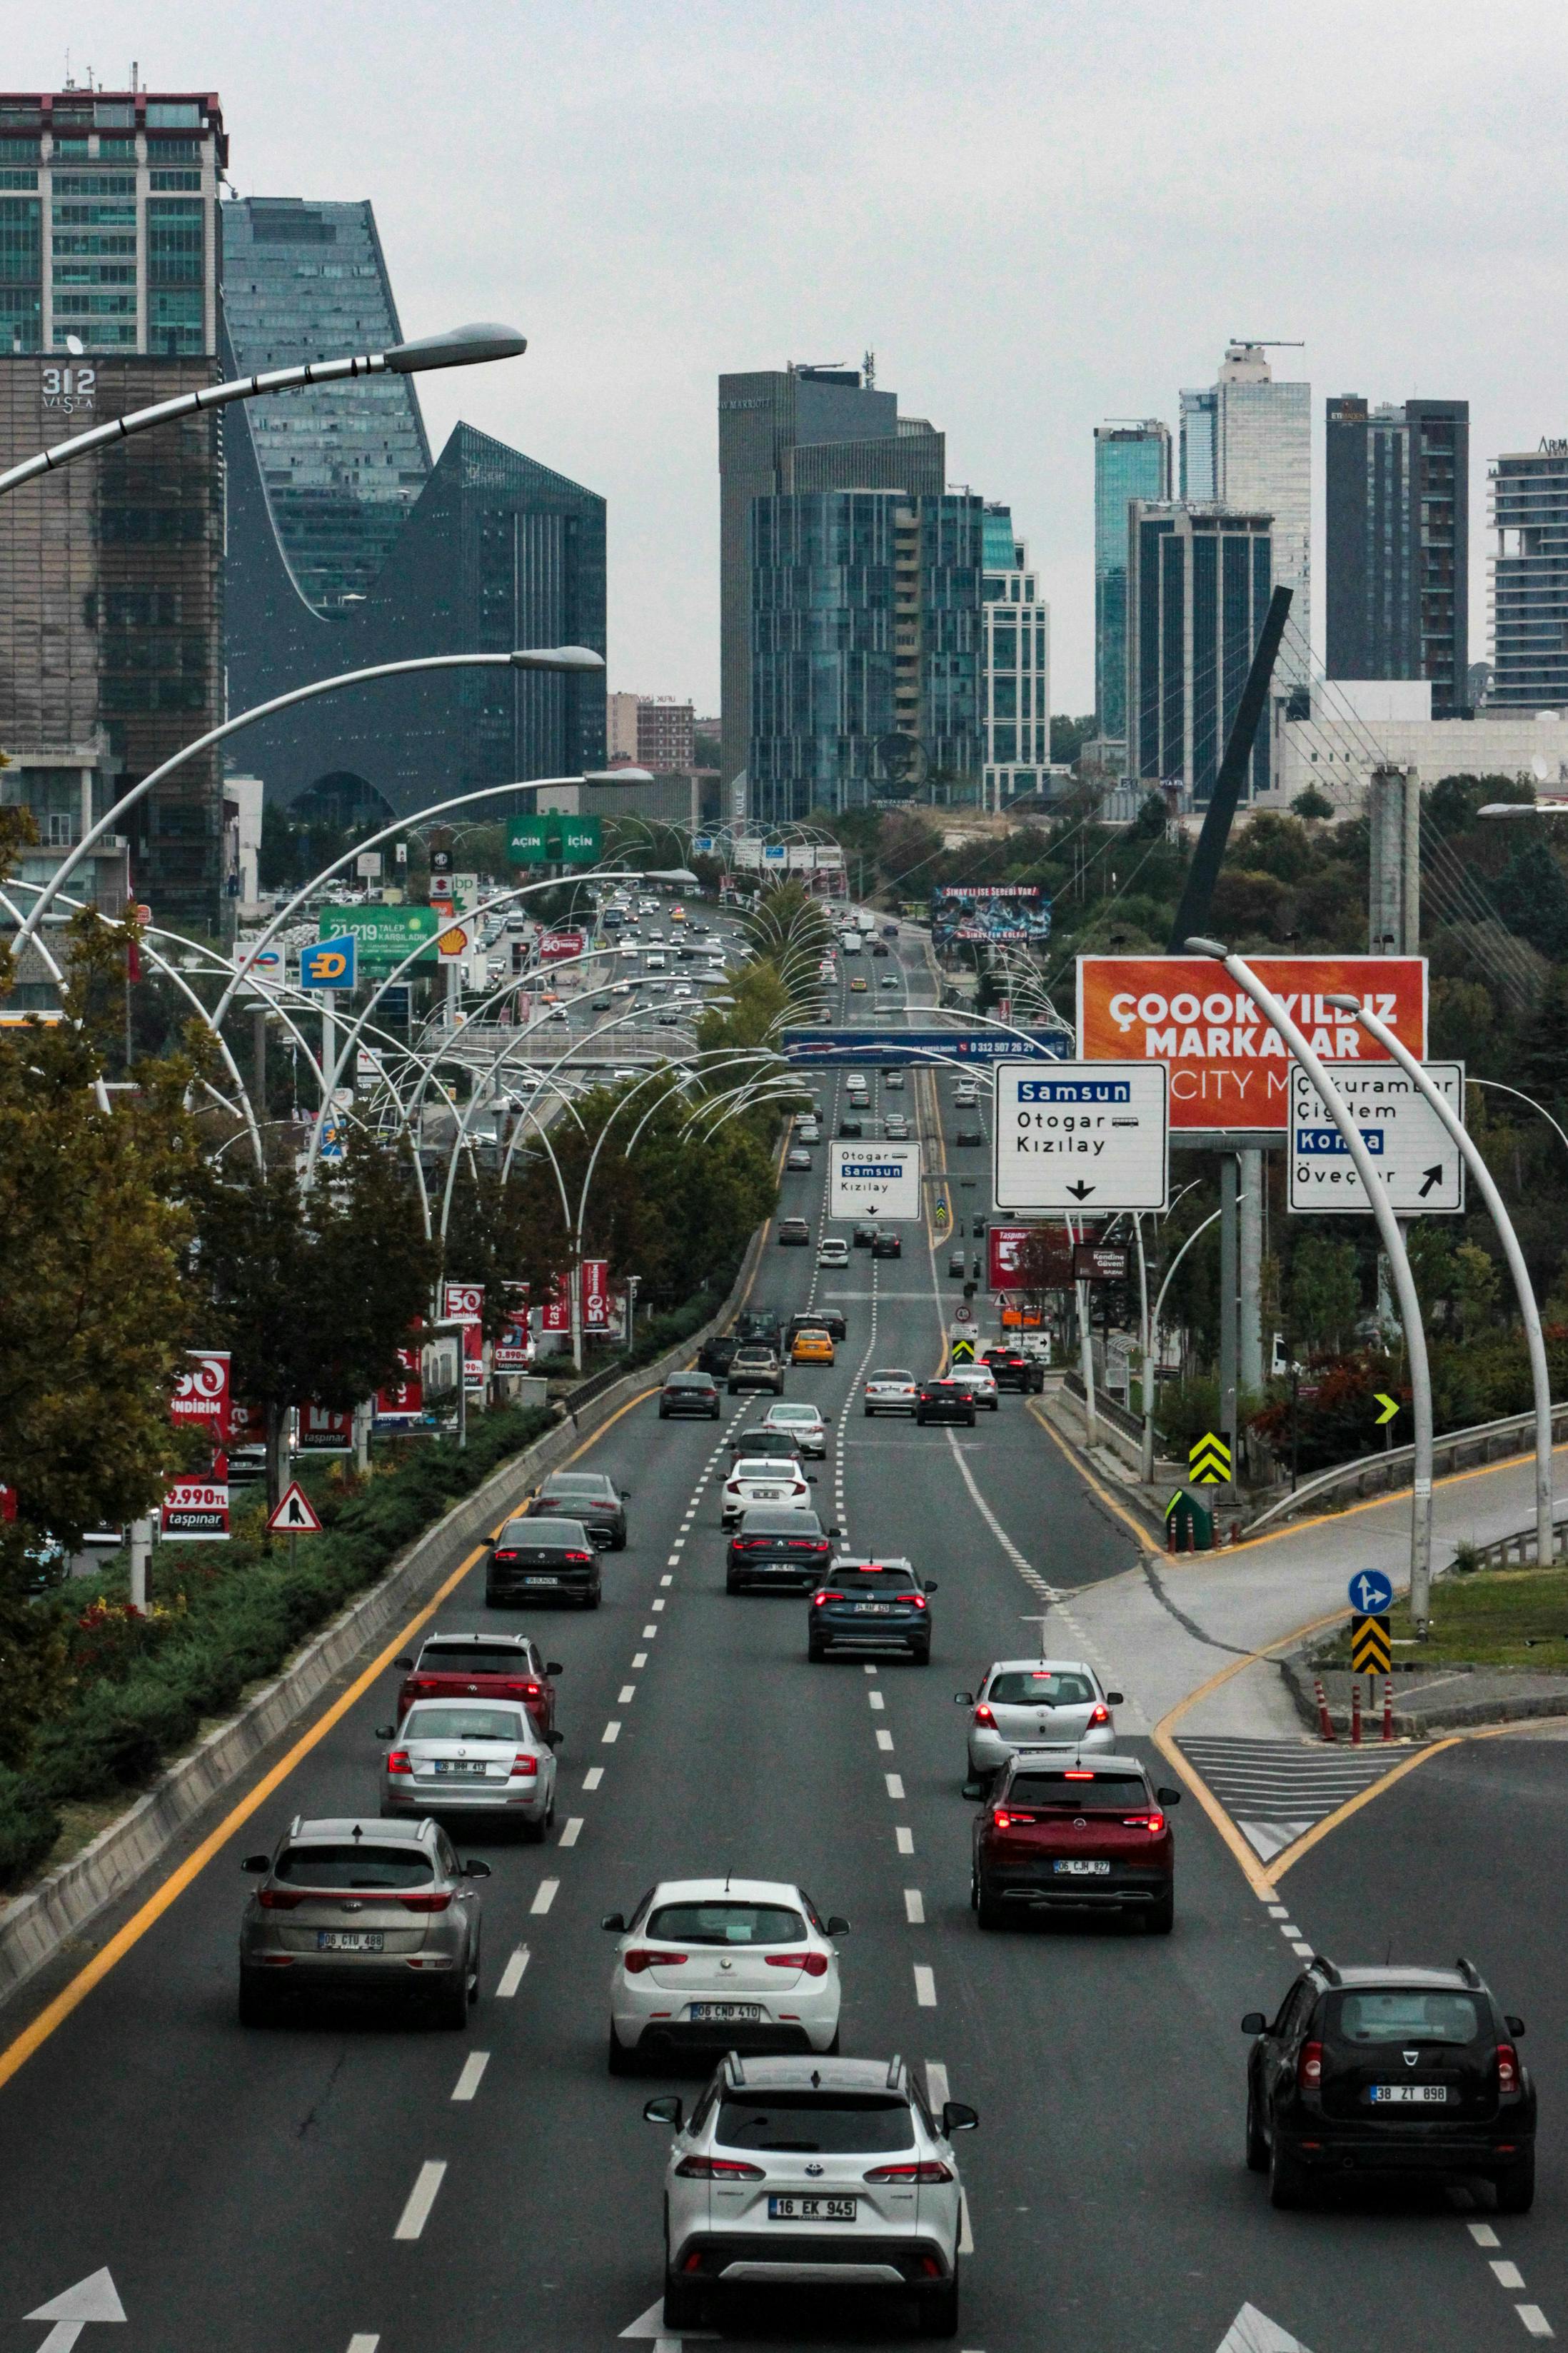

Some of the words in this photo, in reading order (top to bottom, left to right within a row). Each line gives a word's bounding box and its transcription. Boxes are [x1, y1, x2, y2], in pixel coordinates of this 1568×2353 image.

[43, 368, 95, 394] 312
[43, 396, 94, 413] VISTA
[730, 398, 770, 408] MARRIOTT
[1538, 435, 1568, 452] ARM
[736, 790, 745, 816] KULE
[511, 837, 541, 848] AÇIN
[568, 835, 593, 848] İÇİN
[455, 876, 473, 891] bp
[378, 933, 428, 942] KARŞILADIK
[1110, 993, 1261, 1033] ÇOOOK
[970, 1043, 976, 1052] 0
[978, 1043, 992, 1052] 312
[994, 1043, 1010, 1052] 507
[1011, 1043, 1022, 1052] 26
[1023, 1043, 1035, 1052] 29
[1146, 1027, 1360, 1058] MARKAAR
[1022, 1084, 1127, 1100] Samsun
[1170, 1070, 1254, 1100] CITY
[1297, 1077, 1453, 1095] Çkuramr
[1017, 1112, 1105, 1132] Otogar
[1017, 1137, 1105, 1156] Kızılay
[1301, 1133, 1379, 1149] Kona
[842, 1151, 889, 1163] Otogar
[845, 1166, 900, 1175] Samsun
[1297, 1163, 1396, 1185] Öveçr
[841, 1183, 888, 1193] Kızılay
[448, 1290, 481, 1311] 50
[465, 1363, 482, 1372] 90TL
[304, 1433, 346, 1444] taşpınar
[169, 1513, 222, 1527] taşpınar
[473, 1762, 486, 1771] 413
[1095, 1862, 1109, 1871] 827
[325, 1935, 336, 1945] 06
[698, 2005, 711, 2016] 06
[738, 2007, 758, 2017] 410
[1377, 2087, 1391, 2099] 38
[1402, 2088, 1414, 2099] ZT
[1424, 2088, 1444, 2099] 898
[779, 2200, 793, 2214] 16
[803, 2201, 819, 2214] EK
[827, 2202, 853, 2216] 945
